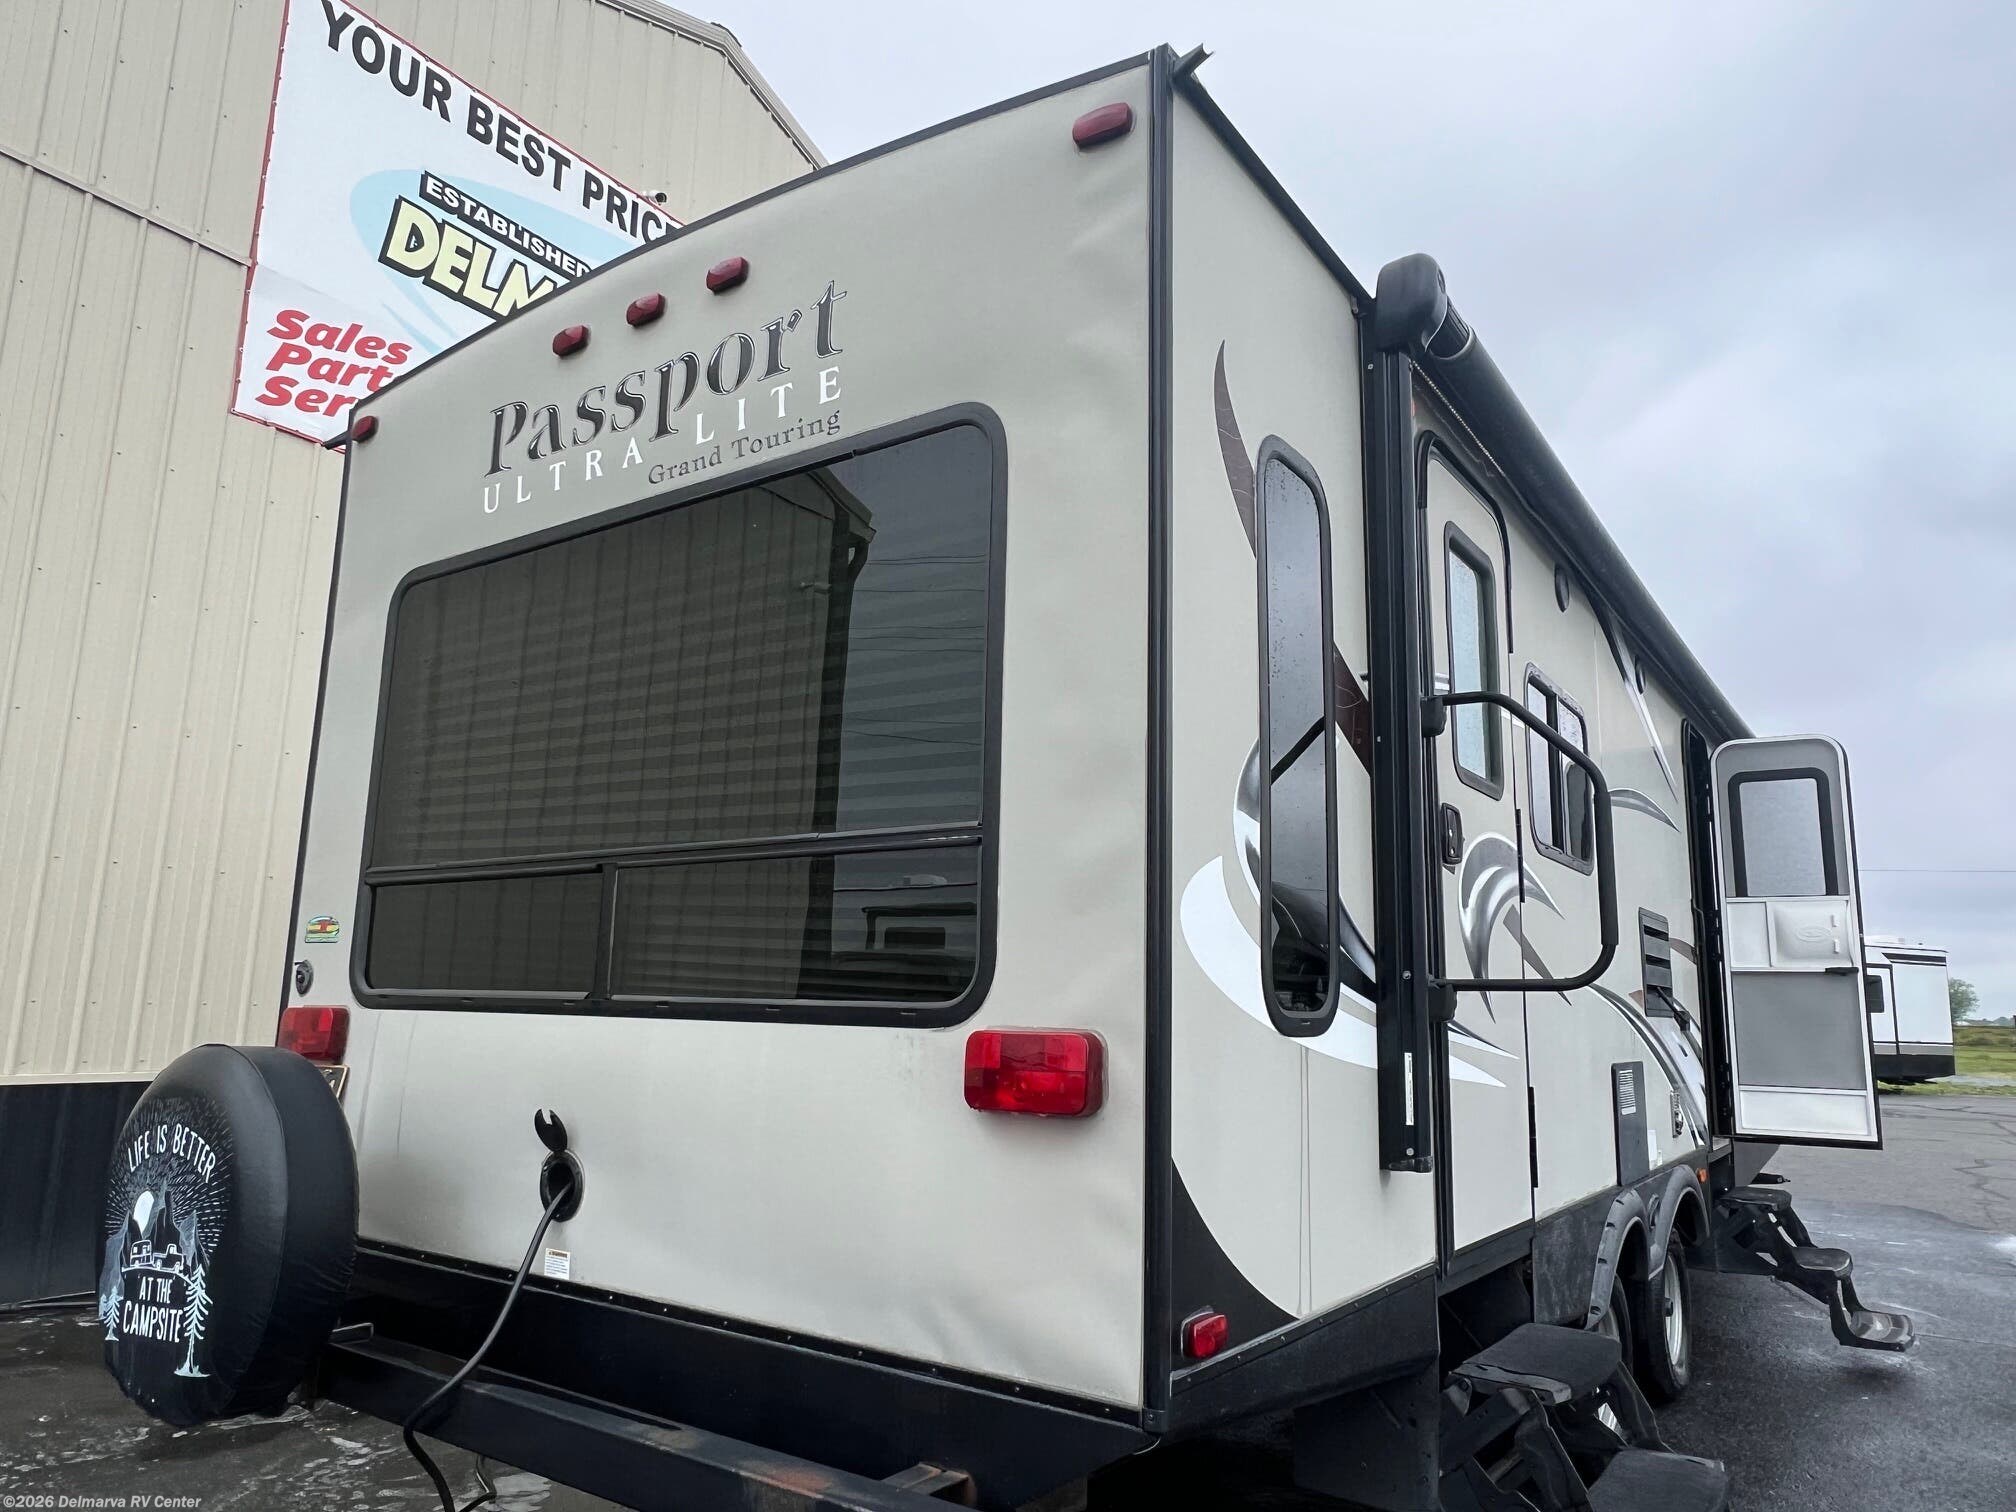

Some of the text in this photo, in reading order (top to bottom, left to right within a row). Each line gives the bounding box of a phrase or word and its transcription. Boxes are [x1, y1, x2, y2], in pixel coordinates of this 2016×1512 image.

[321, 0, 681, 244] YOUR BEST PRIC
[267, 310, 413, 364] Sales
[484, 280, 848, 478] Passport
[484, 366, 842, 513] ULTRA LITE
[648, 410, 841, 484] Grand Touring
[128, 1123, 216, 1183] LIFE IS BETTER
[123, 1301, 184, 1343] CAMPSITE
[138, 1278, 173, 1304] AT THE
